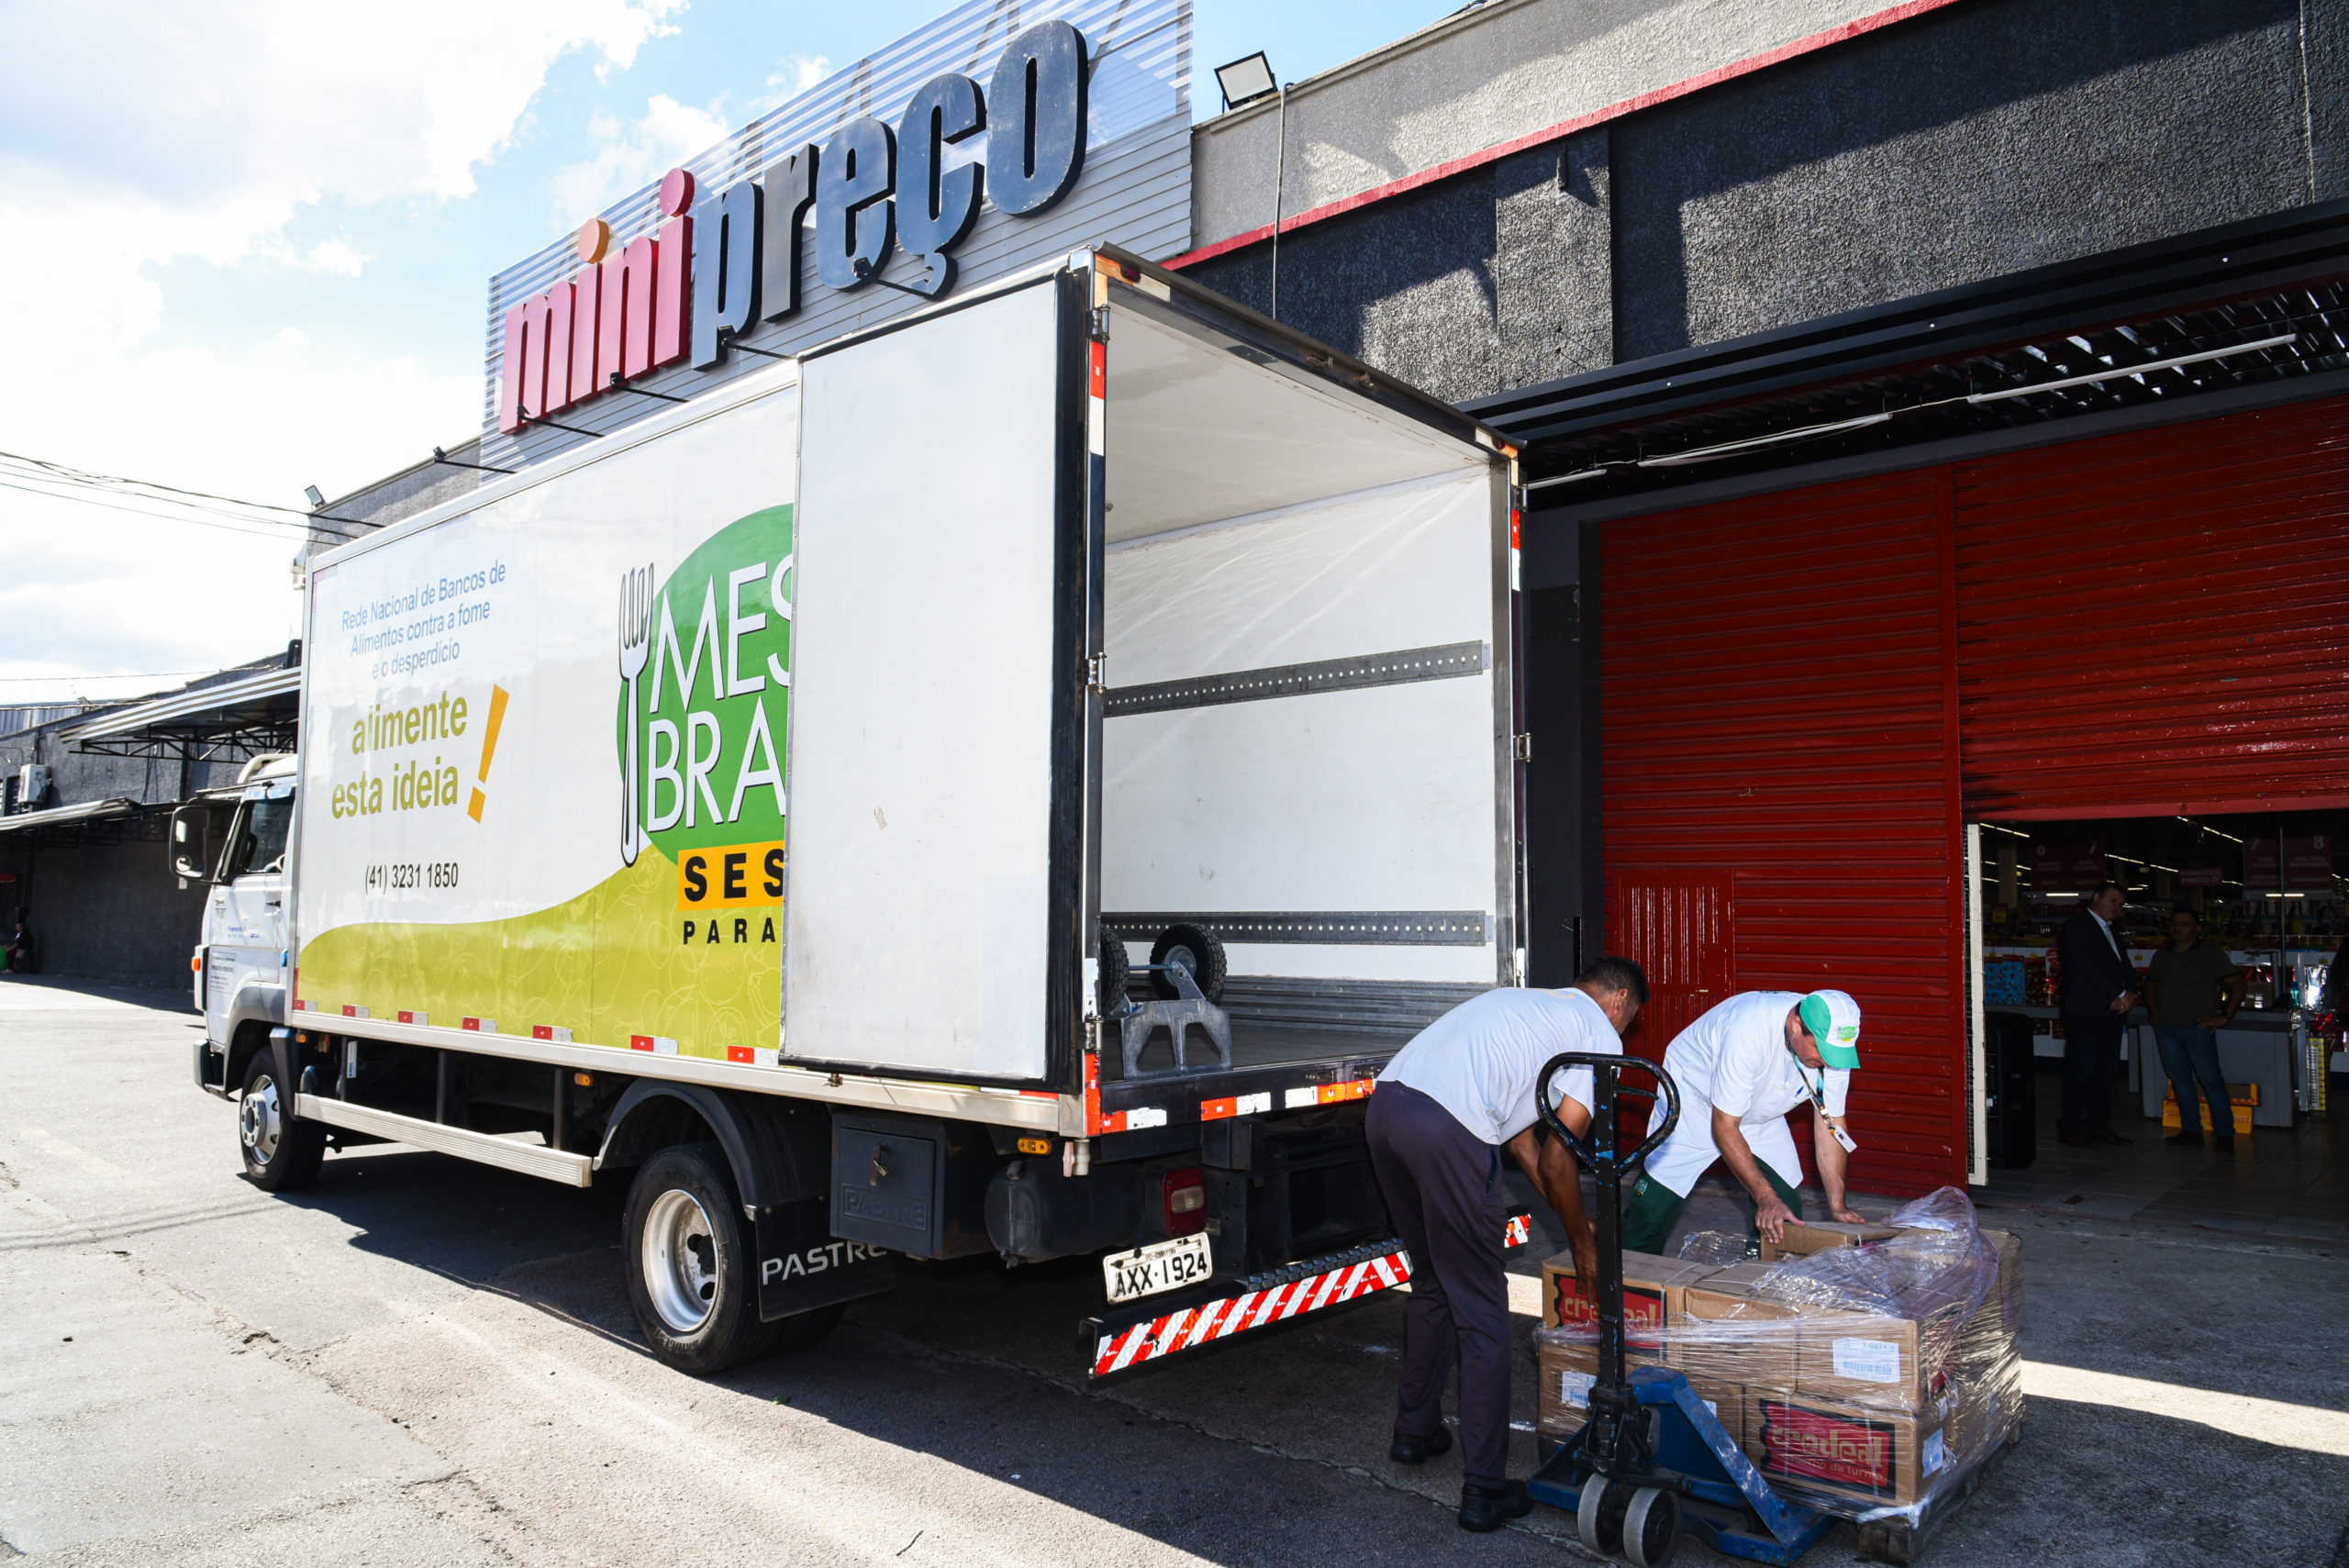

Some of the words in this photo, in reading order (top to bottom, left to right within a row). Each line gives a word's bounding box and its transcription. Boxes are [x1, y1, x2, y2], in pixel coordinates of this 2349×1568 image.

[499, 18, 1089, 435] minipreço
[342, 606, 368, 631] Rede
[370, 587, 418, 623] Nacional
[421, 584, 435, 607] de
[439, 570, 485, 602] Bancos
[489, 560, 506, 584] de
[351, 626, 404, 657] Alimentos
[406, 613, 444, 641] contra
[448, 612, 454, 630] a
[458, 601, 490, 627] fome
[373, 663, 379, 679] e
[382, 661, 389, 677] o
[391, 638, 460, 676] desperdício
[352, 690, 467, 755] alimente
[331, 771, 383, 818] esta
[392, 756, 458, 810] ideia
[647, 695, 786, 832] BRA
[2313, 834, 2324, 850] 8
[365, 863, 387, 895] (41)
[391, 862, 421, 888] 3231
[427, 862, 459, 888] 1850
[684, 848, 784, 902] SES
[684, 917, 776, 945] PARA
[1772, 1426, 1883, 1468] credeal
[1830, 1462, 1843, 1473] da
